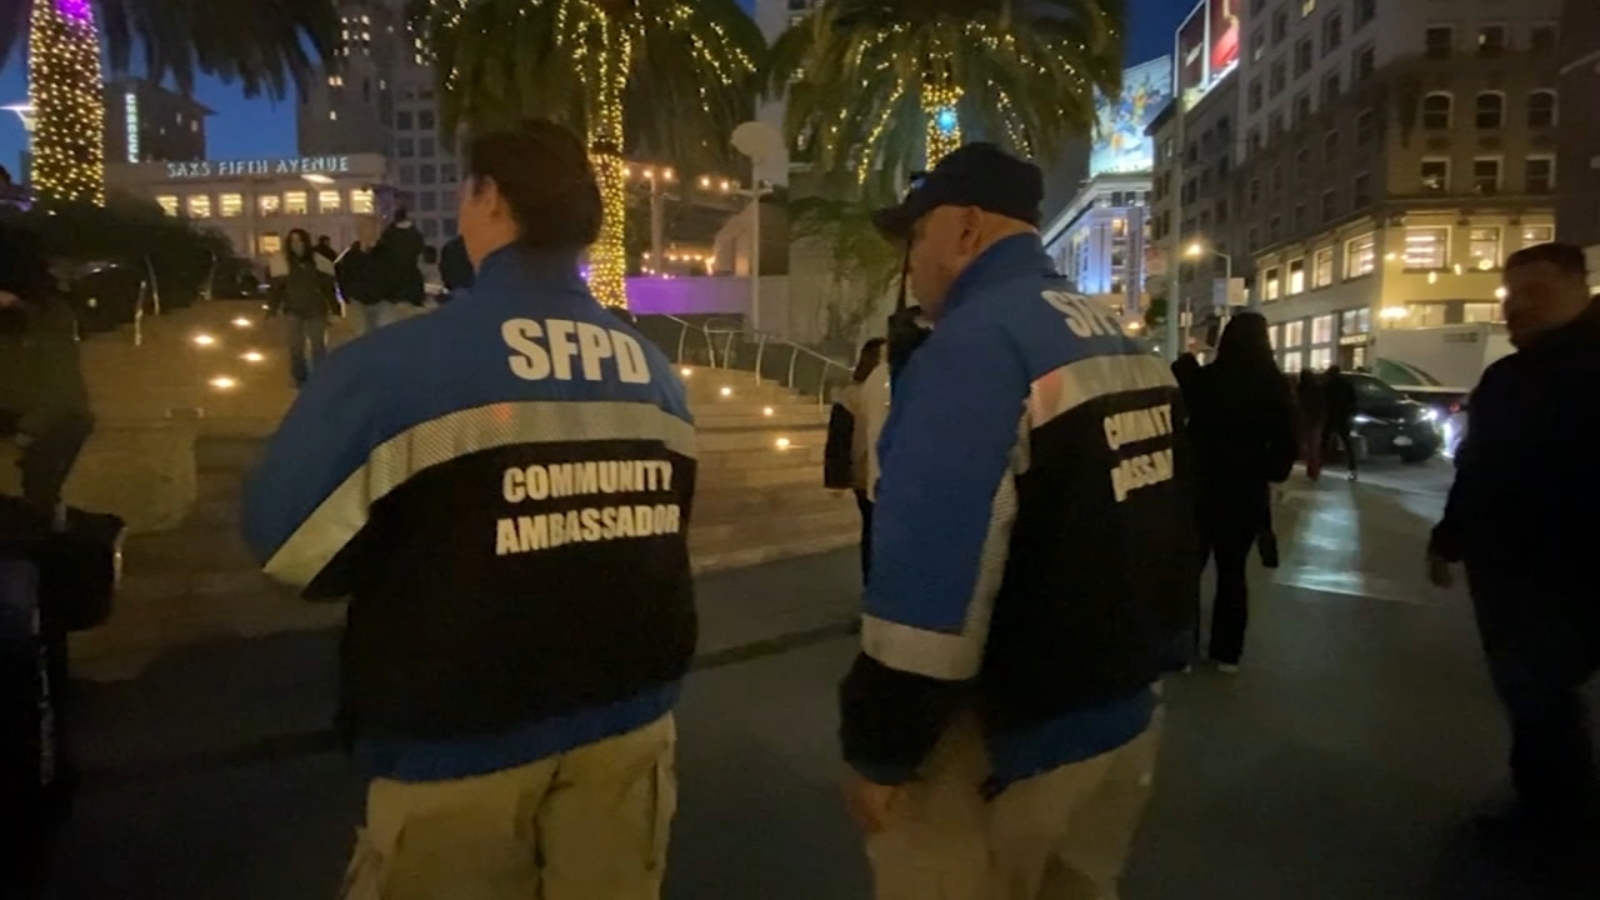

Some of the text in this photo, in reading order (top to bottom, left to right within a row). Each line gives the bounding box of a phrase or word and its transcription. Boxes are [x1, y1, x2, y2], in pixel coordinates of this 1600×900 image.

[218, 159, 269, 176] FIFTH
[276, 156, 350, 174] AVENUE
[501, 317, 651, 385] SFPD
[502, 459, 673, 503] COMMUNITY
[496, 503, 681, 556] AMBASSADOR
